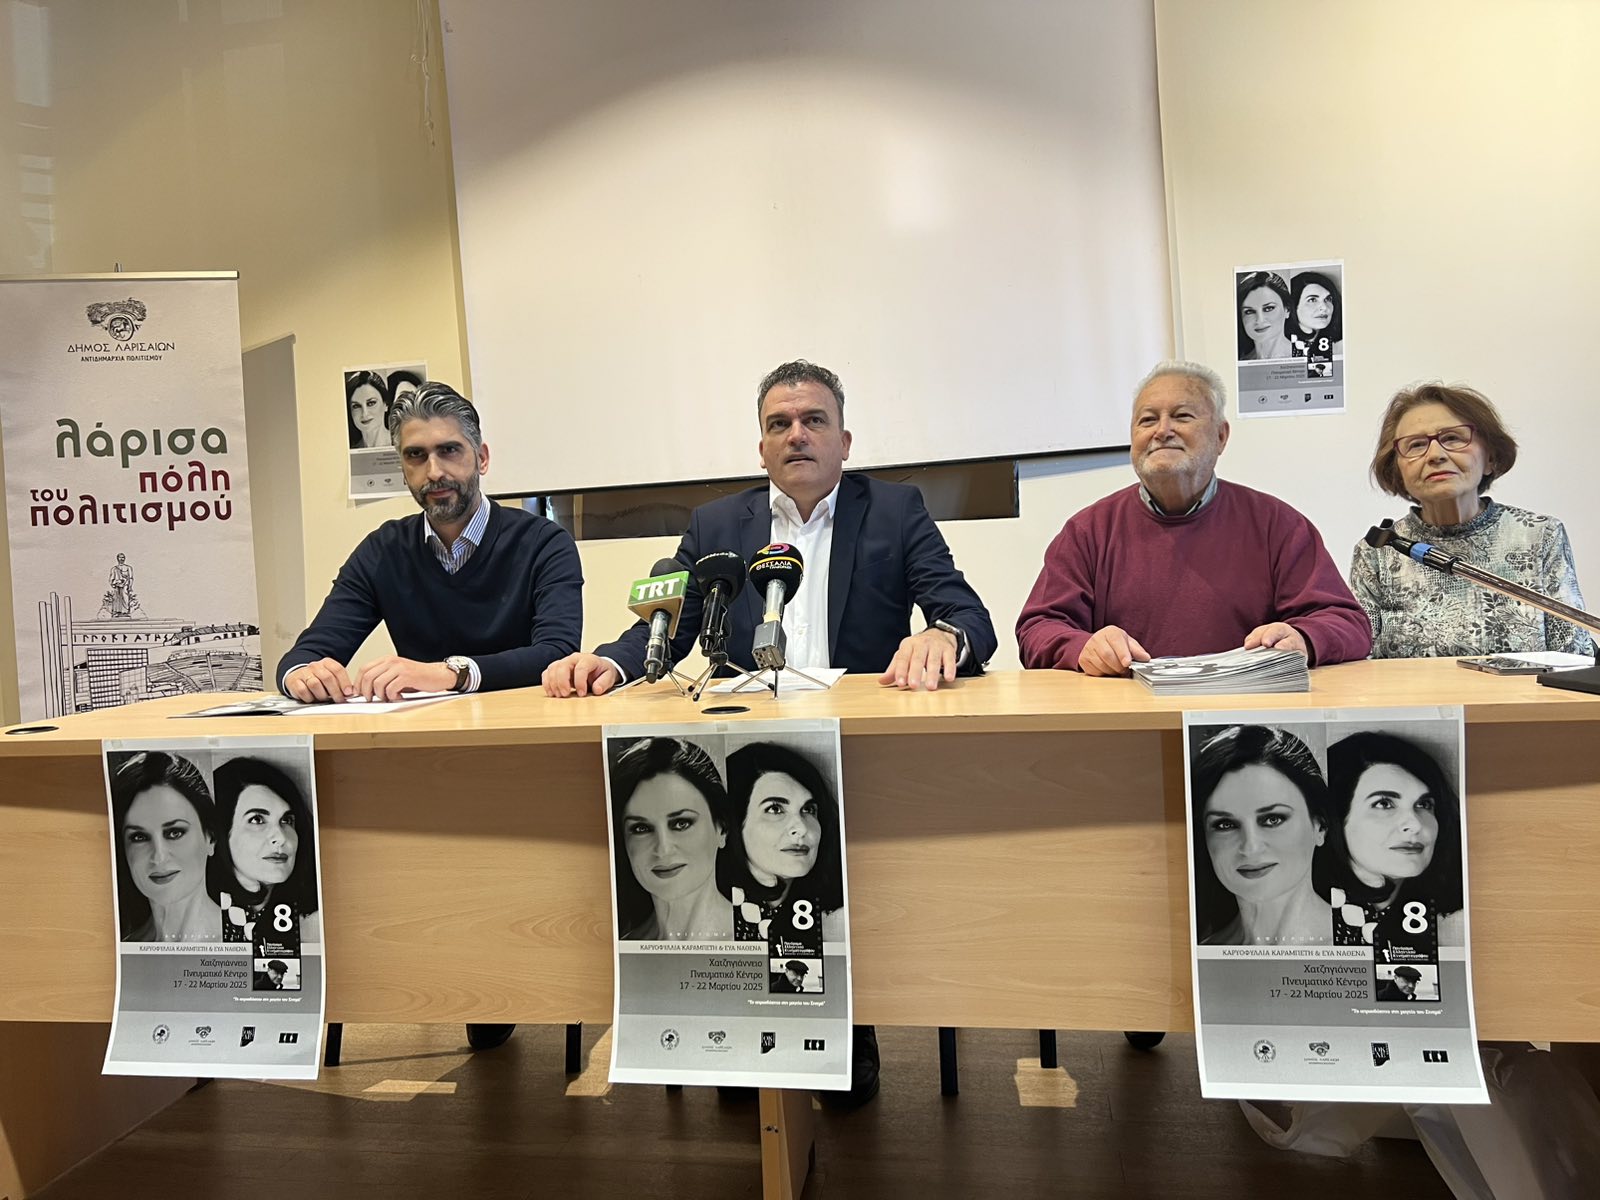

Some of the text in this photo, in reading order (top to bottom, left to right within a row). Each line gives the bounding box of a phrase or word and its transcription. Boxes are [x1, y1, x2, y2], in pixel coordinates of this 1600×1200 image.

[67, 342, 175, 353] ΔΗΜΟΣ ΛΑΡΙΣΑΙΩΝ
[1318, 337, 1329, 351] 8
[56, 418, 228, 468] λάρισα
[139, 460, 230, 493] πόλη
[30, 488, 68, 502] του
[30, 494, 232, 531] πολιτισμού
[636, 578, 680, 600] TRT
[274, 904, 293, 932] 8
[792, 900, 814, 930] 8
[1402, 901, 1428, 934] 8
[200, 959, 248, 968] Χατζηγιάννειο
[709, 959, 763, 968] Χατζηγιάννειο
[183, 970, 248, 979] Πνευματικό Κέντρο
[690, 970, 763, 980] Πνευματικό Κέντρο
[1303, 964, 1367, 975] Χατζηγιάννειο
[200, 981, 228, 989] Μαρτίου
[680, 982, 689, 990] 17
[696, 982, 706, 990] 22
[708, 982, 741, 992] Μαρτίου
[743, 982, 763, 991] 2025
[1282, 977, 1368, 988] Πνευματικό Κέντρο
[1270, 989, 1281, 998] 17
[1290, 989, 1302, 998] 22
[1304, 989, 1342, 1000] Μαρτίου
[1345, 990, 1368, 999] 2025
